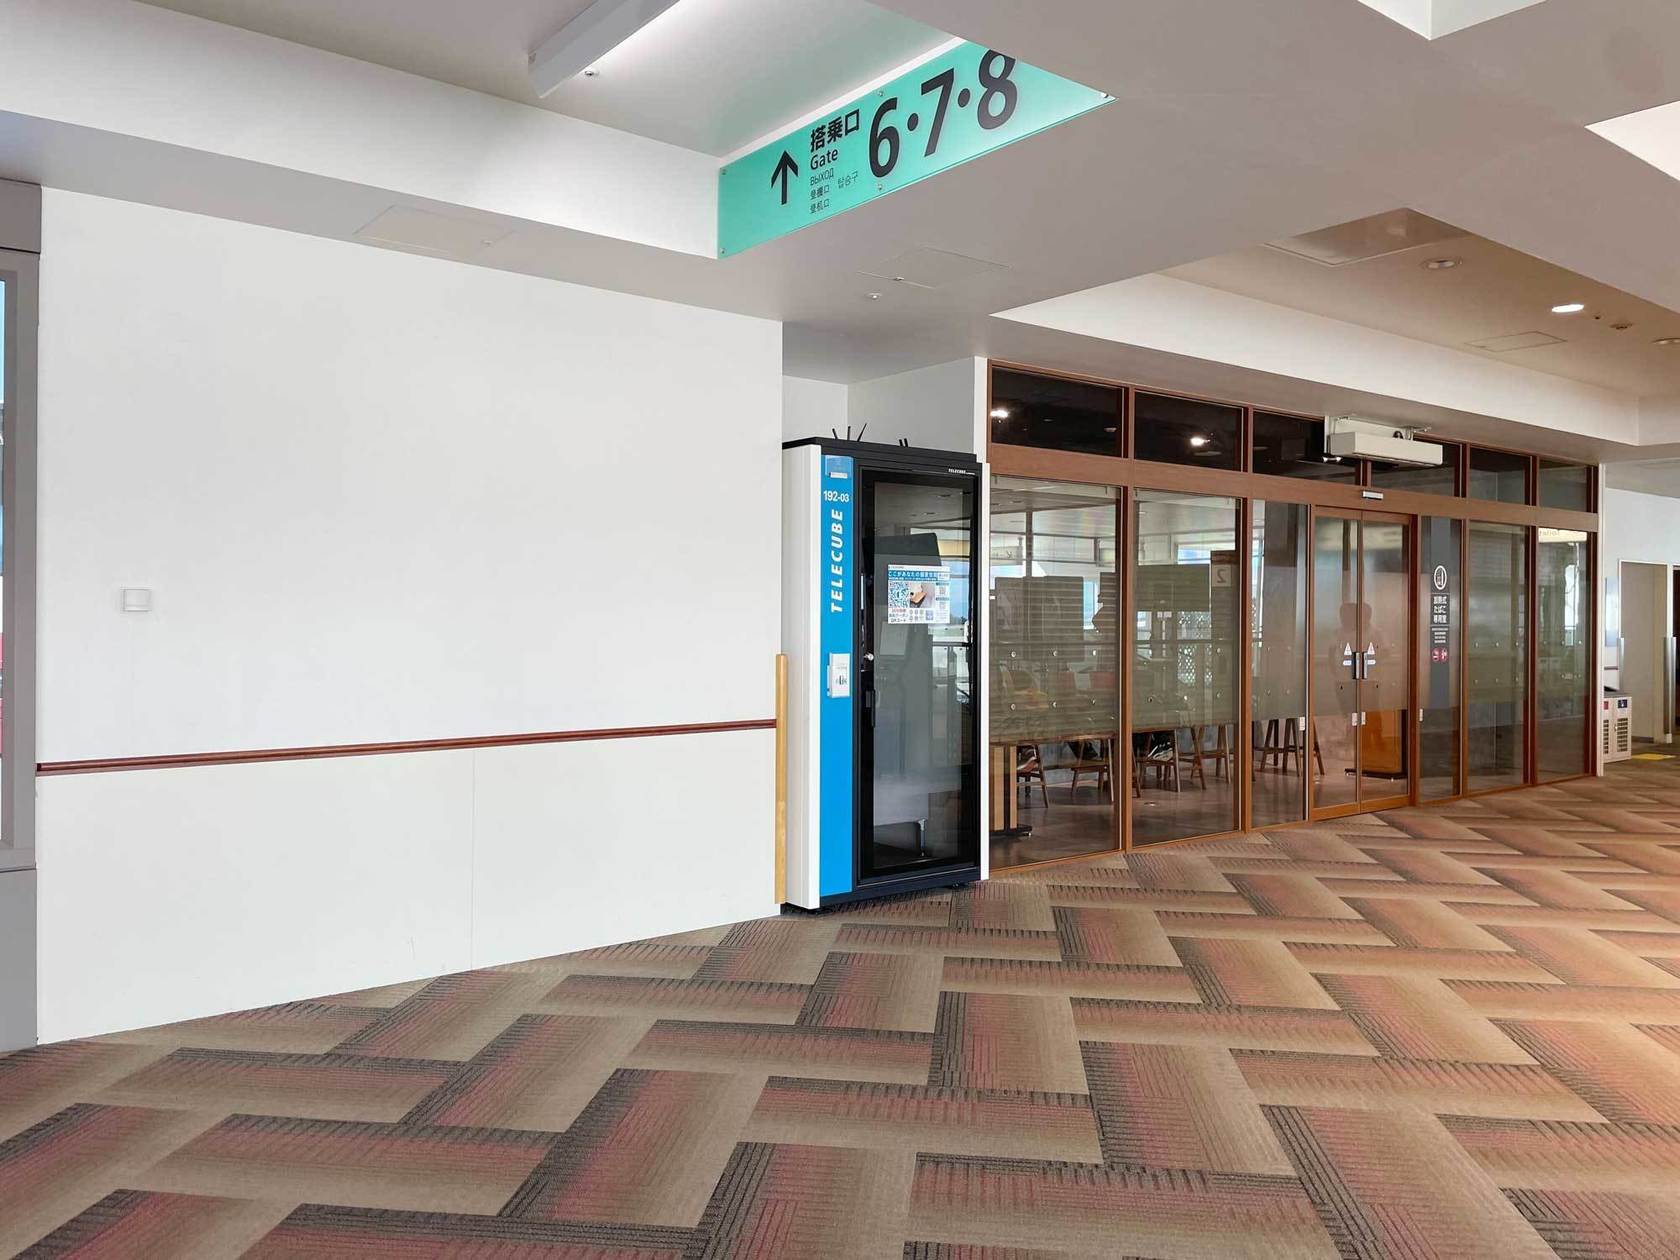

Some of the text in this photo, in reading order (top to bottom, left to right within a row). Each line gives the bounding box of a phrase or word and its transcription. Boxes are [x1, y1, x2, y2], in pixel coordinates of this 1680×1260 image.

[810, 108, 860, 153] 搭乗口
[810, 149, 839, 170] Gate
[810, 167, 835, 186] ВЫХОД
[823, 490, 850, 503] 192-03
[831, 508, 843, 614] TELECUBE
